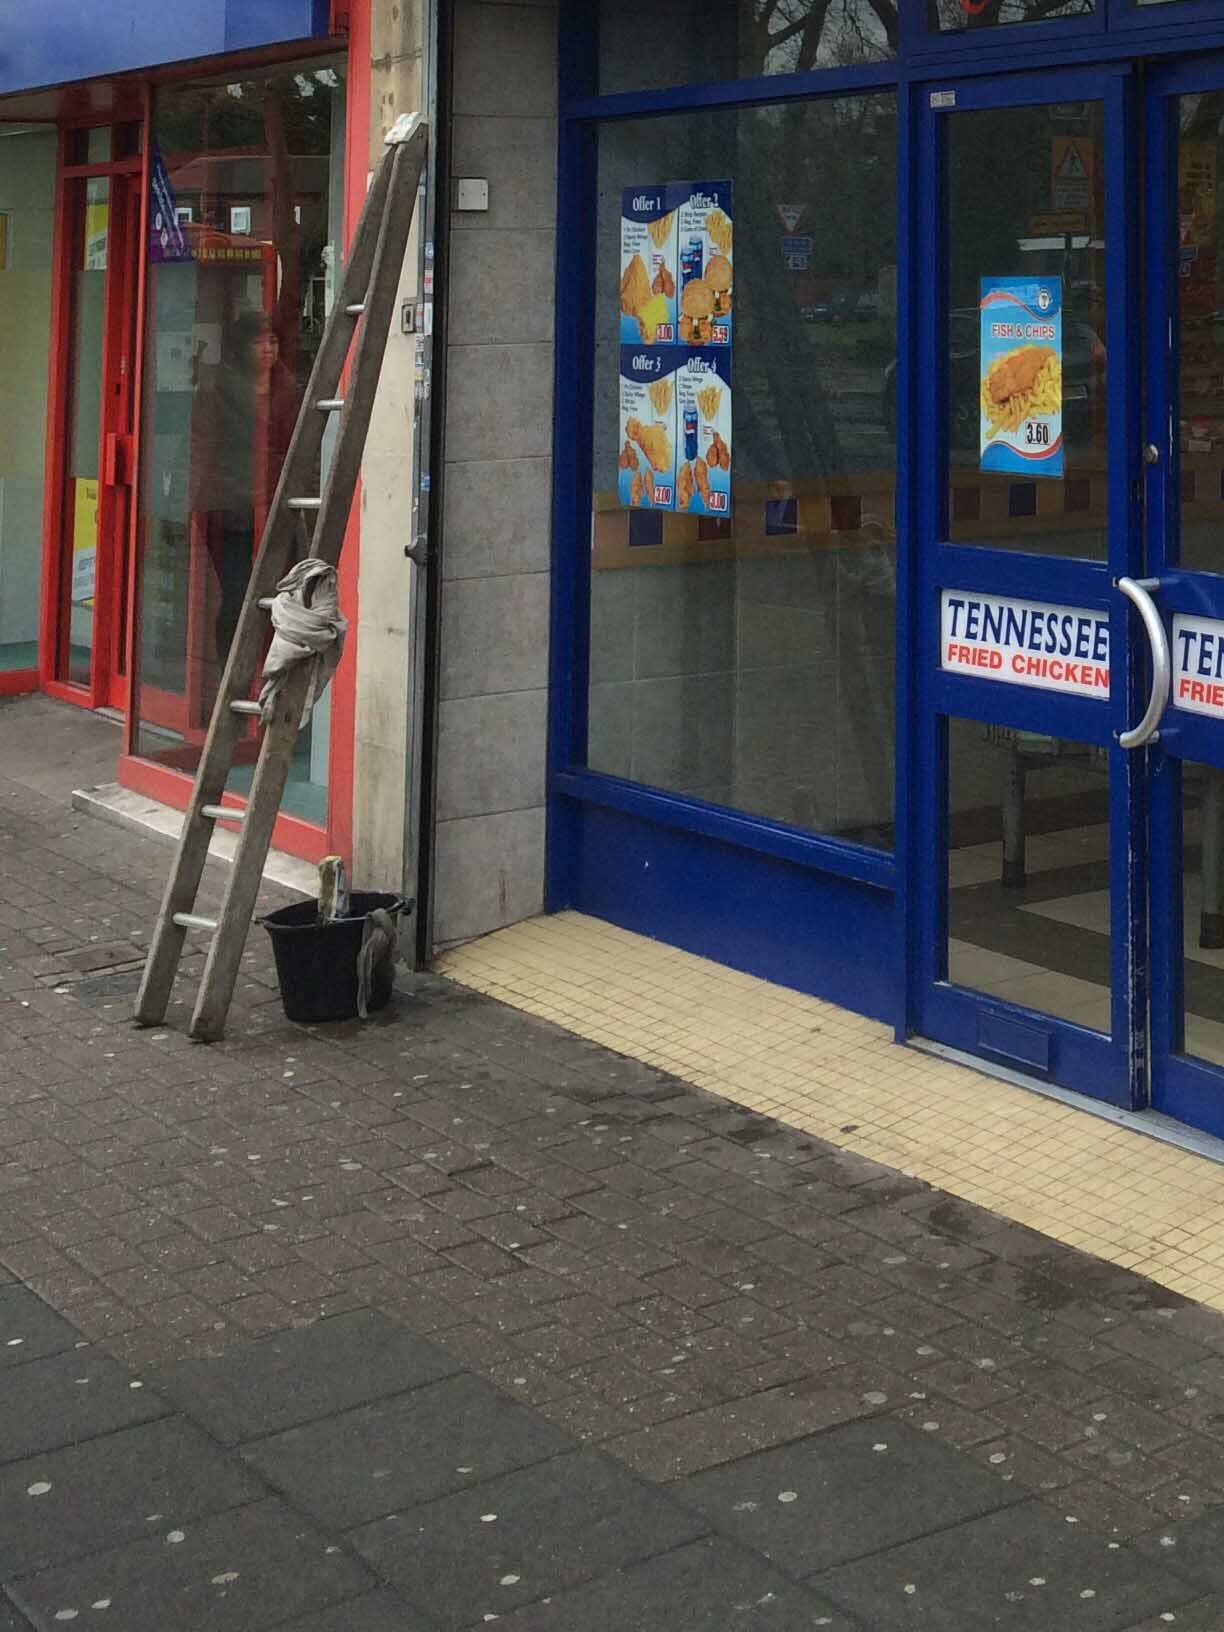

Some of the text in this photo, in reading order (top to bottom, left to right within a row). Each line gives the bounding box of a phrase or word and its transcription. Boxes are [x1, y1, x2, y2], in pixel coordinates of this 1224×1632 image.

[633, 194, 654, 211] Offer
[992, 323, 1056, 340] FISH & CHIPS
[632, 354, 654, 371] Offer
[687, 356, 710, 374] Offer
[1027, 423, 1049, 444] 3.60
[948, 598, 1110, 661] TENNESSEE
[947, 644, 1110, 689] FRIED CHICKEN
